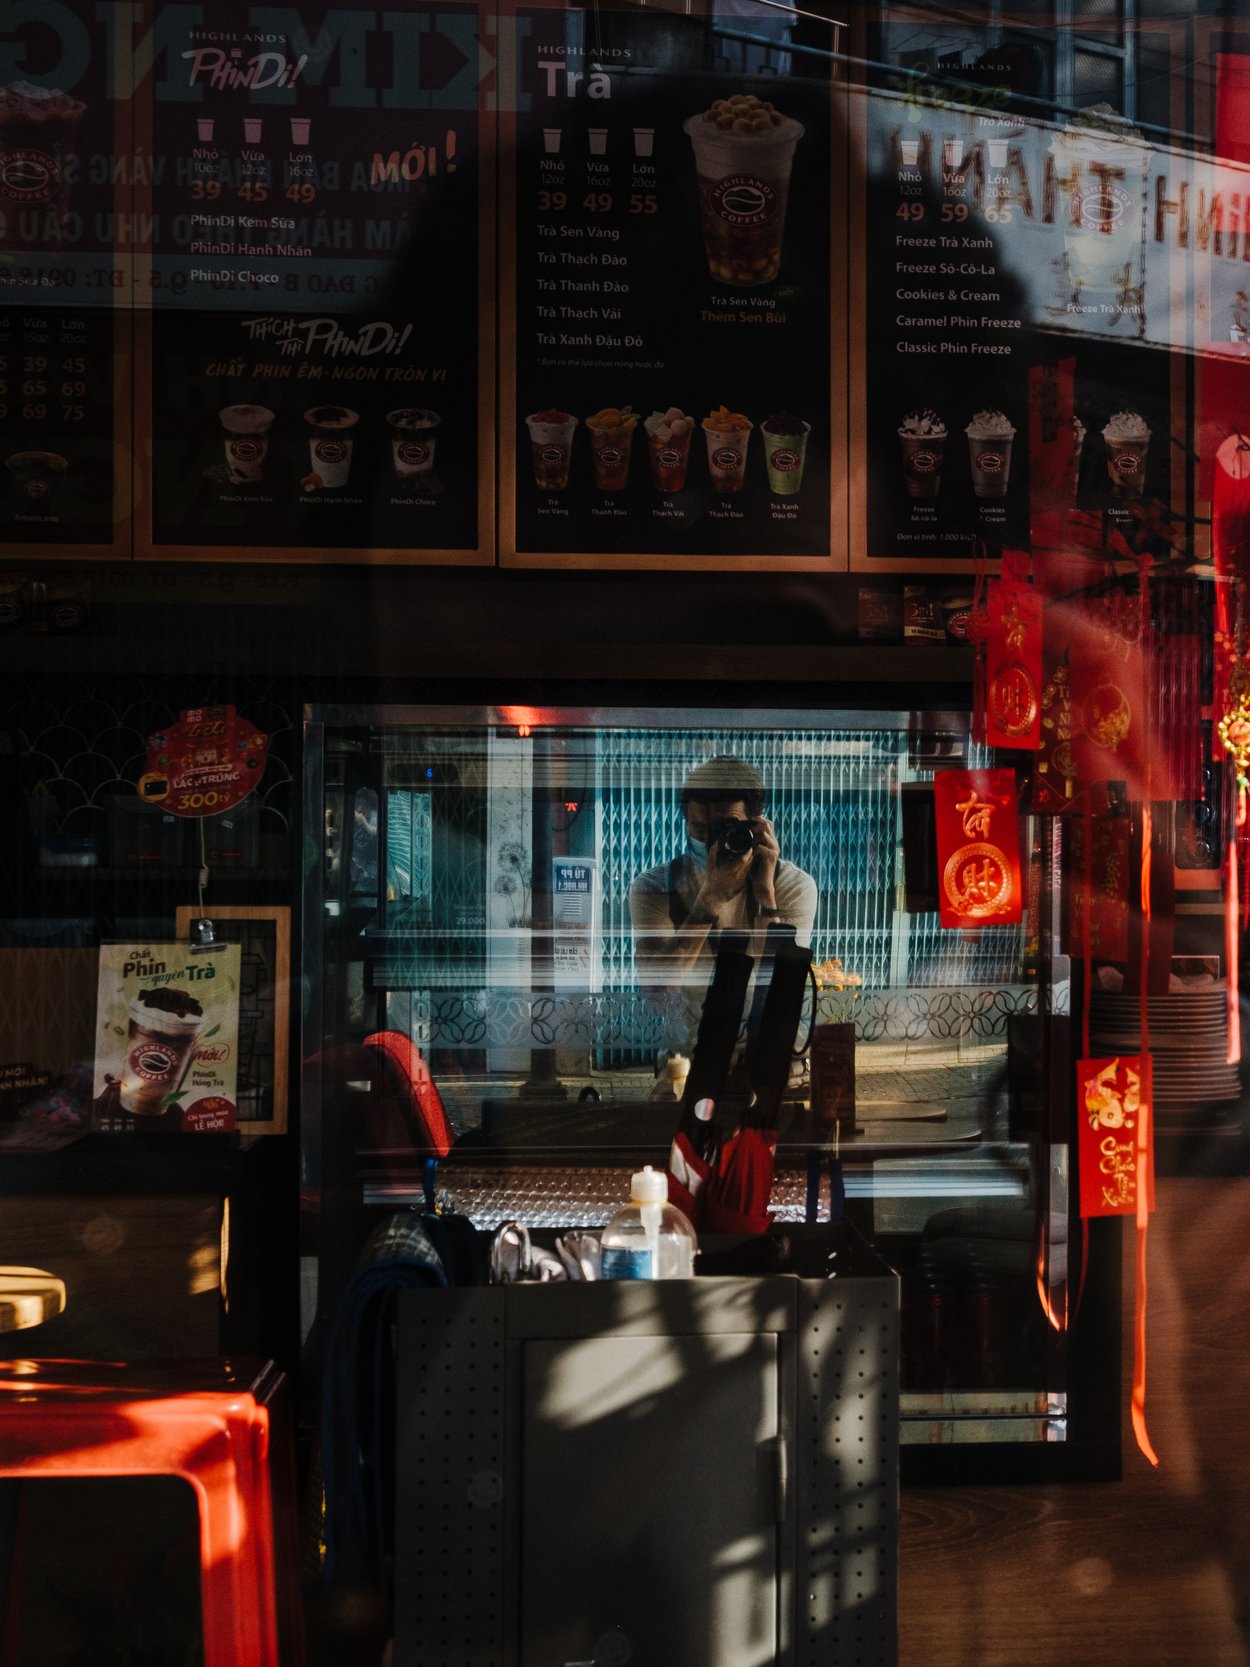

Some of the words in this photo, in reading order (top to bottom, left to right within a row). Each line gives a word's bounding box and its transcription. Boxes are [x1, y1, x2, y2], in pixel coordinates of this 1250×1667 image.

[189, 32, 287, 43] HIGHLANDS
[538, 45, 632, 58] HIGHLANDS
[538, 61, 612, 99] Trà
[193, 146, 218, 160] Nhỏ
[241, 149, 265, 161] Vừa
[288, 151, 313, 164] Lớn
[241, 165, 266, 176] 12oz
[288, 166, 314, 177] 16oz
[540, 159, 565, 171] Nhỏ
[586, 160, 609, 173] Vừa
[633, 162, 655, 175] Lớn
[541, 174, 567, 185] 12oz
[586, 175, 611, 187] 16oz
[631, 176, 657, 188] 20oz
[898, 171, 922, 183] Nhỏ
[943, 173, 965, 184] Vừa
[987, 173, 1009, 185] Lớn
[191, 181, 220, 200] 39
[238, 183, 268, 202] 45
[284, 184, 316, 203] 49
[899, 185, 922, 196] 12oz
[943, 187, 966, 198] 16oz
[538, 191, 568, 211] 39
[582, 193, 613, 213] 49
[629, 194, 658, 214] 55
[896, 202, 925, 222] 49
[940, 204, 968, 223] 59
[984, 204, 1013, 224] 65
[191, 215, 234, 228] PhinDi
[238, 216, 267, 229] Kem
[271, 215, 296, 230] Sữa
[537, 224, 557, 237] Trà
[559, 226, 584, 238] Sen
[586, 225, 620, 241] Vàng
[896, 236, 936, 247] Freeze
[940, 236, 959, 248] Trà
[961, 236, 993, 248] Xanh
[191, 242, 234, 256] PhinDi
[238, 243, 273, 259] Hạnh
[277, 243, 312, 257] Nhân
[537, 252, 557, 265] Trà
[560, 252, 598, 267] Thạch
[601, 254, 627, 266] Đào
[896, 262, 936, 274] Freeze
[940, 262, 995, 275] Sô-Cô-La
[191, 269, 234, 283] PhinDi
[238, 271, 279, 284] Choco
[537, 279, 557, 292] Trà
[559, 280, 600, 293] Thanh
[603, 281, 630, 294] Đào
[711, 296, 726, 305] Trà
[729, 297, 747, 305] Sen
[750, 297, 776, 308] Vàng
[896, 288, 944, 300] Cookies
[948, 289, 957, 301] &
[960, 290, 1000, 301] Cream
[536, 306, 557, 319] Trà
[559, 307, 598, 322] Thạch
[600, 306, 622, 320] Vải
[1067, 303, 1098, 313] Freeze
[1100, 303, 1115, 313] Trà
[1116, 303, 1141, 314] Xanh
[739, 311, 762, 322] Sen
[896, 315, 947, 327] Caramel
[950, 315, 977, 328] Phin
[981, 316, 1021, 328] Freeze
[536, 333, 557, 346] Trà
[559, 334, 593, 347] Xanh
[595, 334, 622, 350] Đậu
[624, 334, 643, 348] Đỏ
[896, 341, 937, 354] Classic
[940, 342, 968, 354] Phin
[971, 342, 1011, 354] Freeze
[23, 356, 48, 373] 39
[62, 357, 86, 373] 45
[252, 363, 293, 379] PHIN
[22, 380, 47, 396] 65
[61, 381, 86, 397] 69
[22, 404, 48, 420] 69
[62, 404, 86, 421] 75
[1108, 508, 1129, 516] Classic
[177, 791, 218, 810] 300
[123, 959, 166, 979] Phin
[185, 962, 216, 981] Trà
